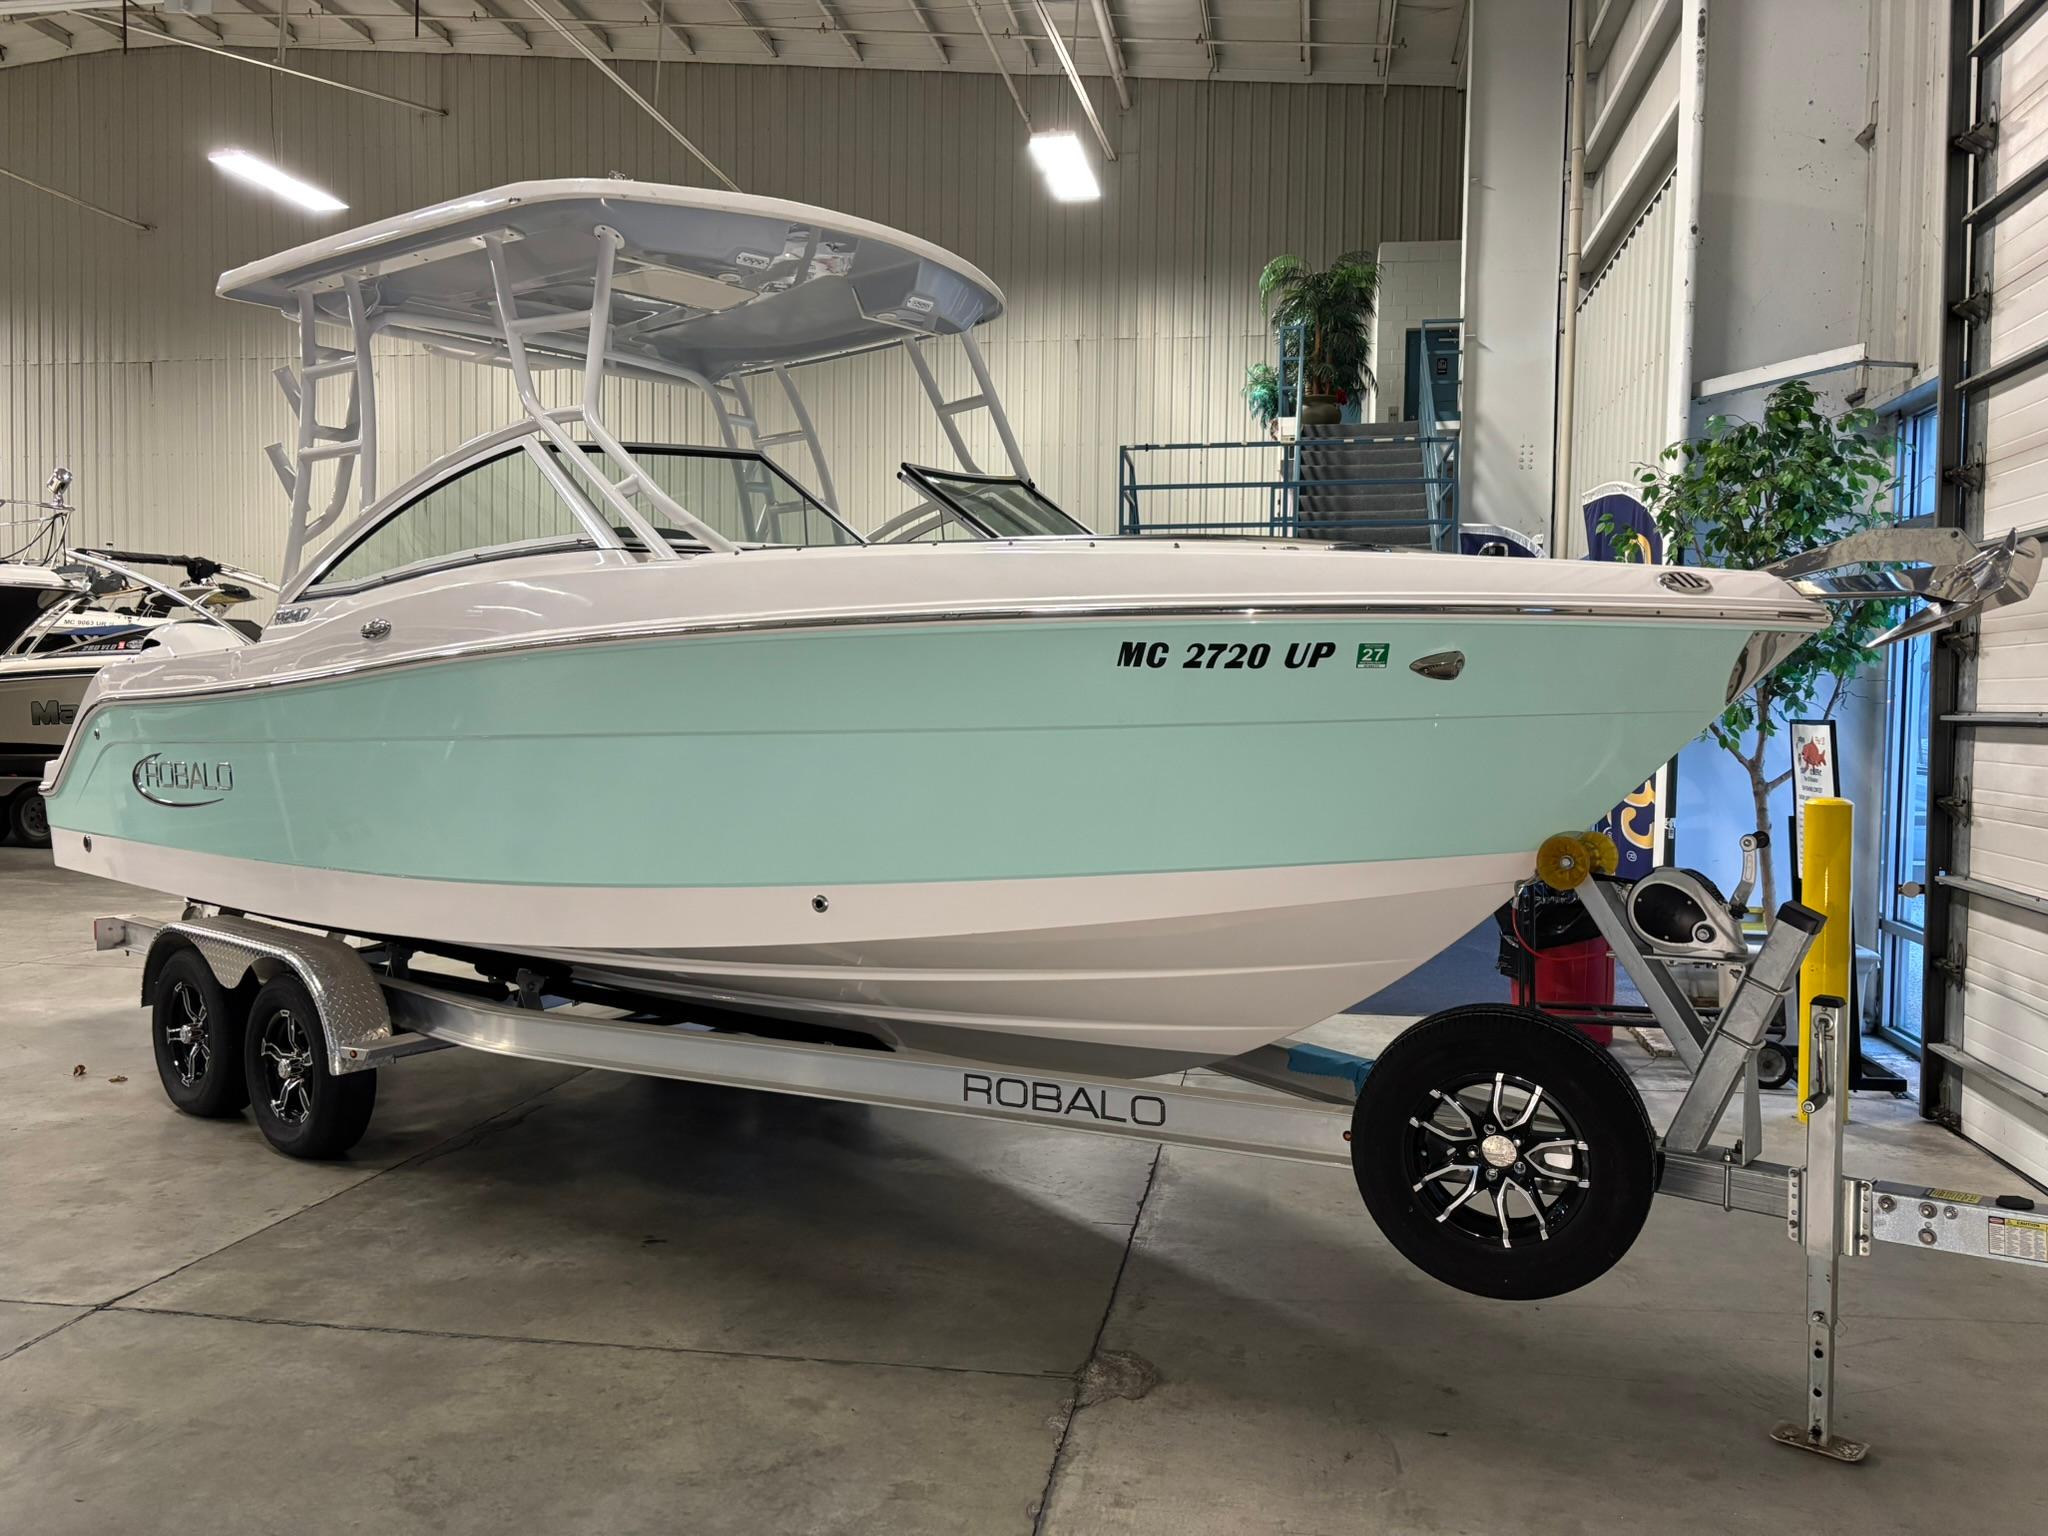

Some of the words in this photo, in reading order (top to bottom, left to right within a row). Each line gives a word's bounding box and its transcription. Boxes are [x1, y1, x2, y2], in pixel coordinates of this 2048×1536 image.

[1117, 641, 1169, 668] MC
[1182, 643, 1271, 669] 2720
[1284, 642, 1336, 669] UP
[1361, 648, 1385, 661] 27
[145, 761, 233, 791] ROBALO
[963, 1073, 1166, 1127] ROBALO
